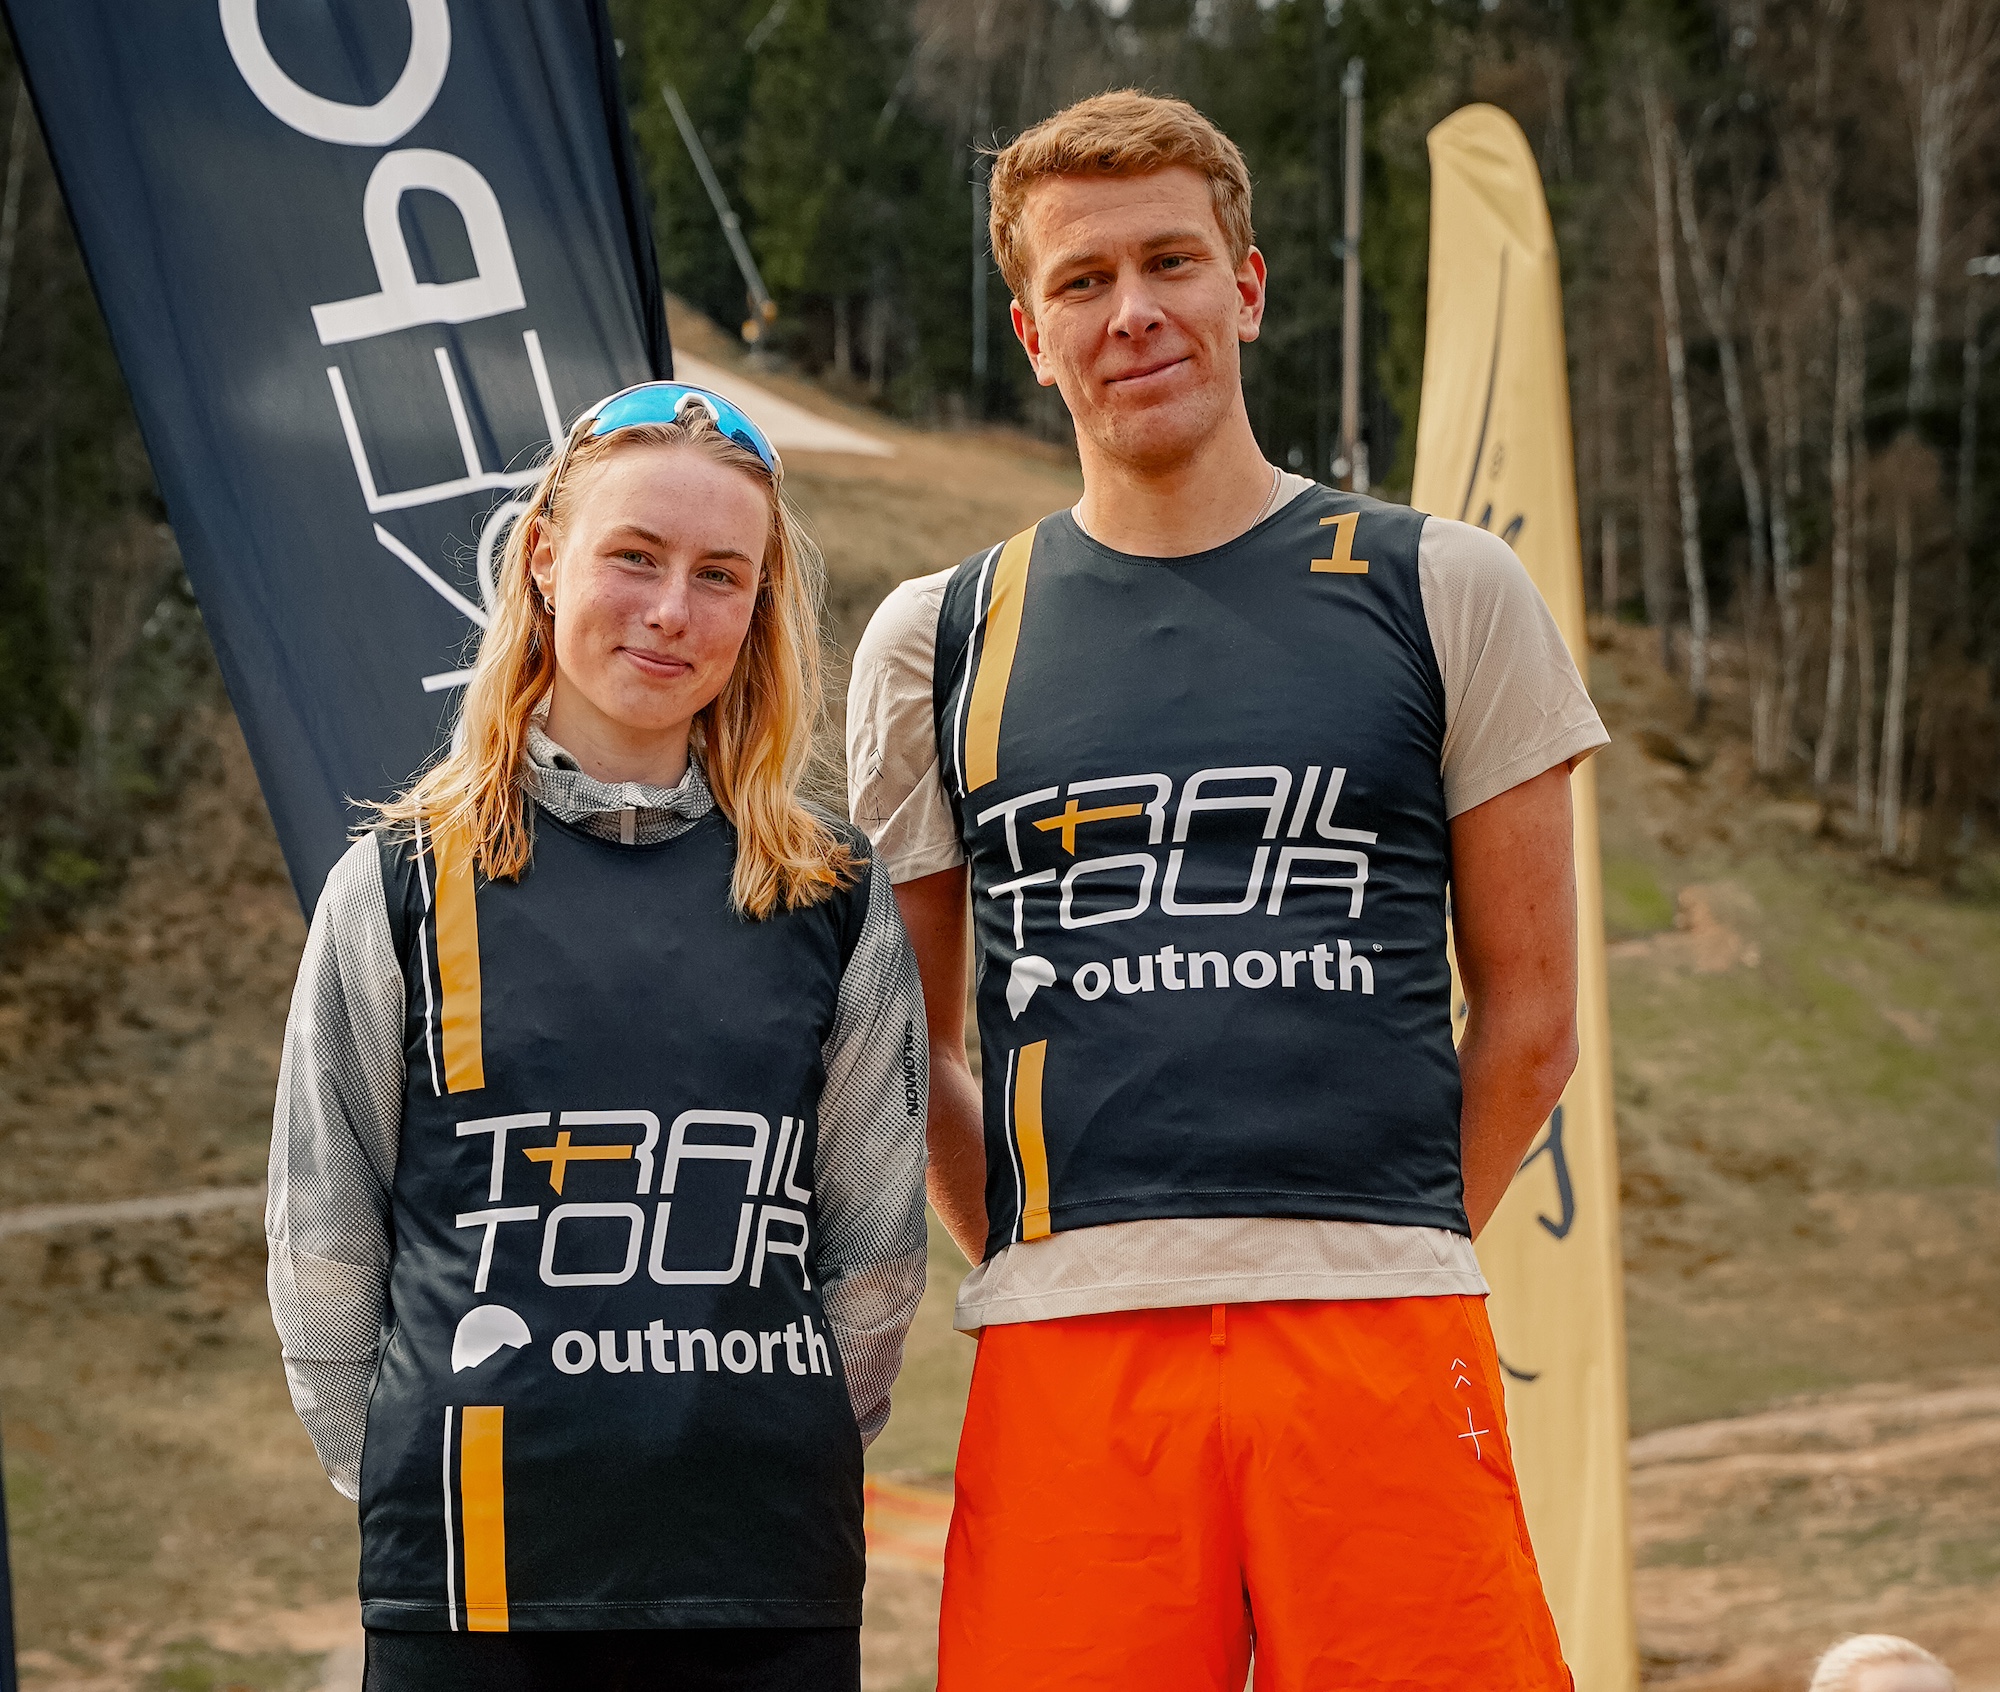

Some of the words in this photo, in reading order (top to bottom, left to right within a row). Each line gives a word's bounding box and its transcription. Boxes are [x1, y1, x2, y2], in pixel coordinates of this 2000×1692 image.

[1310, 512, 1370, 575] 1
[977, 765, 1379, 873] TRAIL
[987, 846, 1369, 951] TOUR
[902, 1020, 919, 1118] SALOMON
[456, 1109, 812, 1205] TRAIL
[456, 1201, 811, 1294] TOUR
[551, 1314, 833, 1376] outnorth
